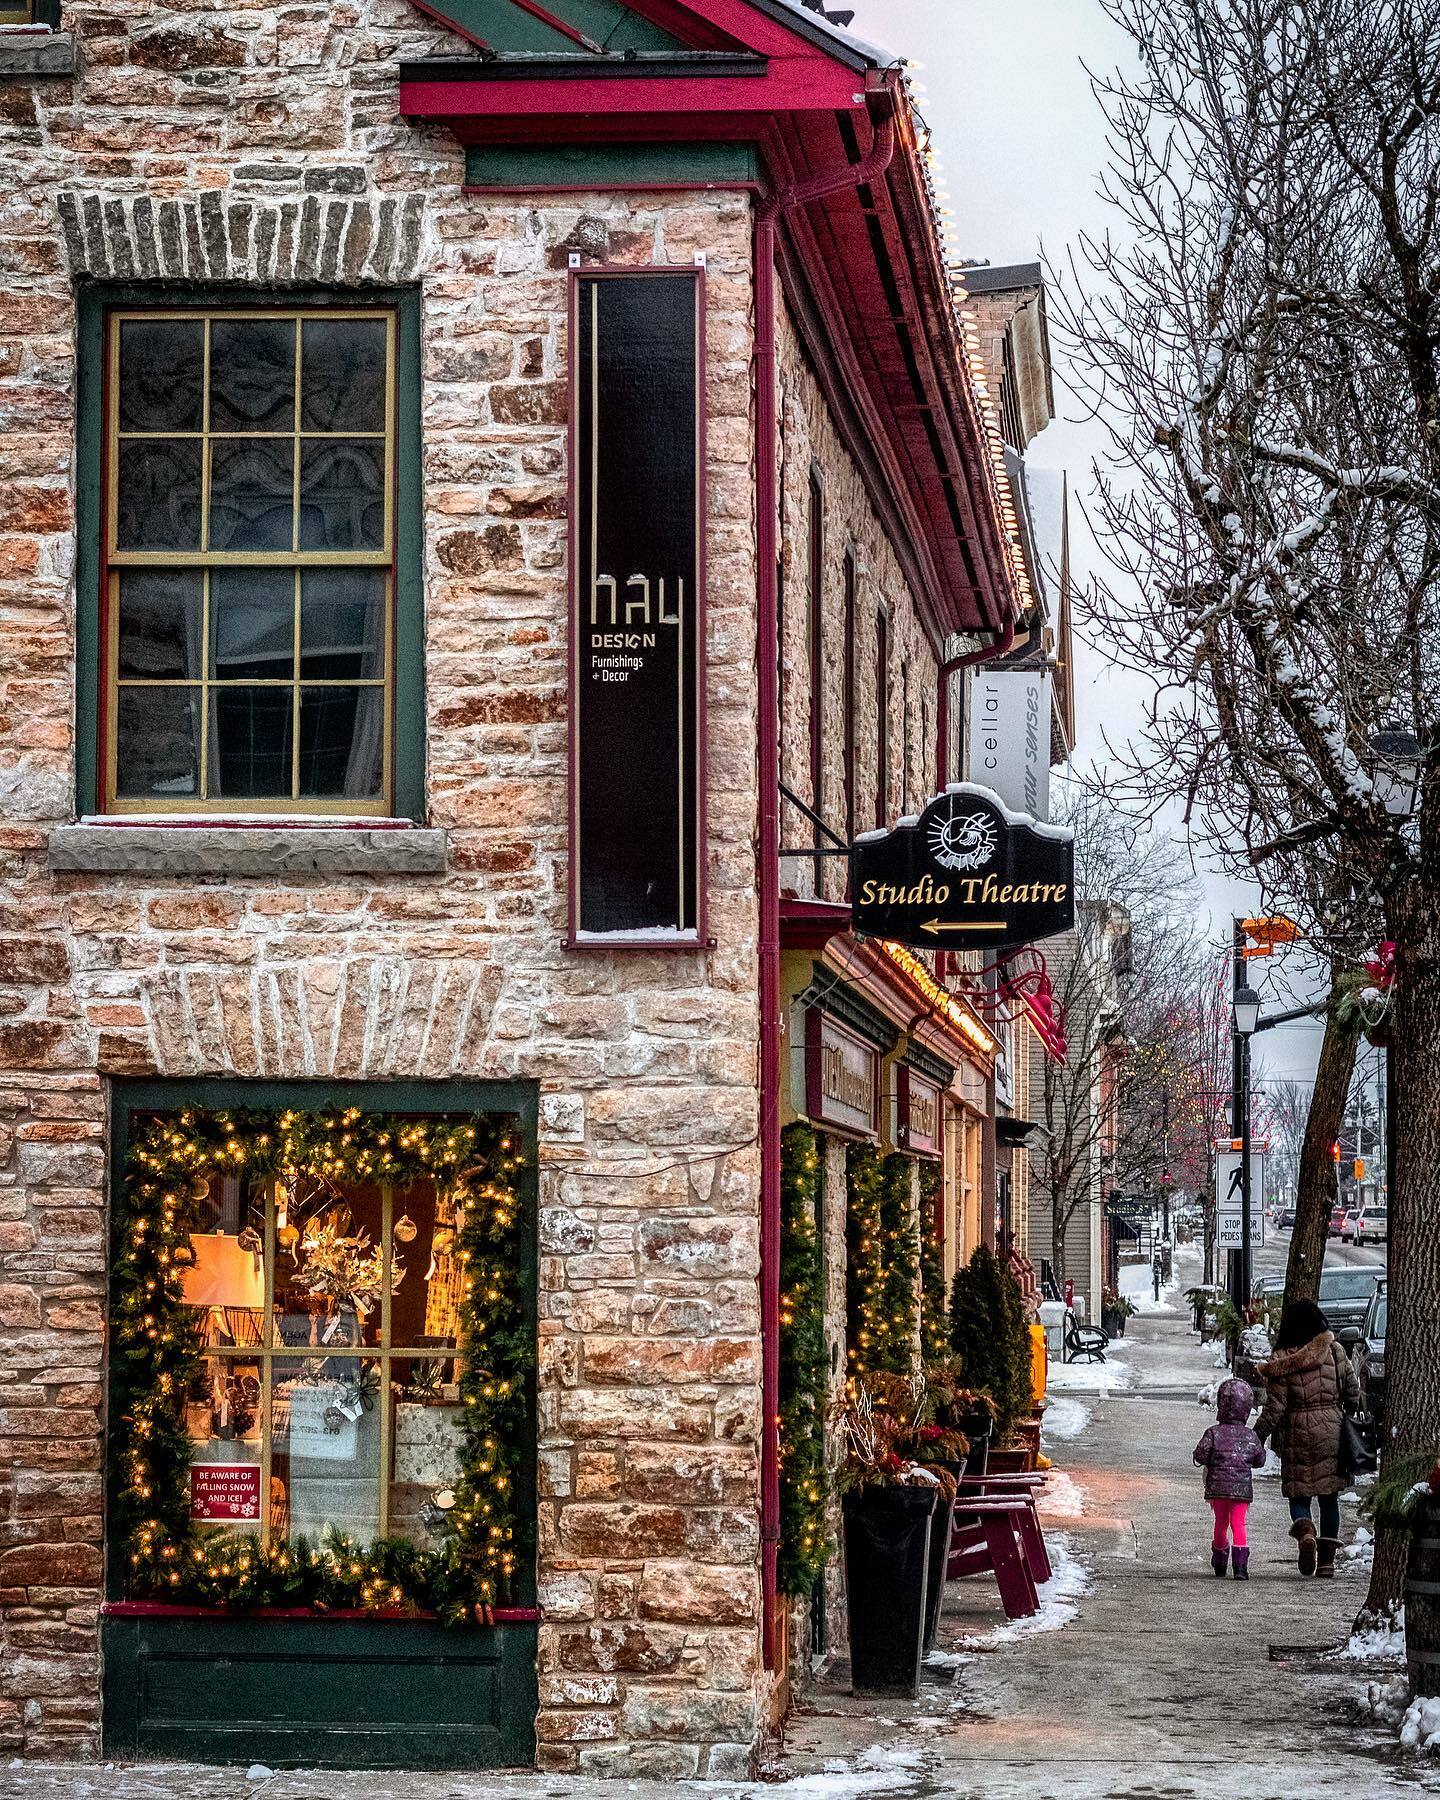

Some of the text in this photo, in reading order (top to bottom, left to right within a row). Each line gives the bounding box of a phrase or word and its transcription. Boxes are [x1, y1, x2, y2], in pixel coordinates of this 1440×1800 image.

[591, 633, 656, 649] DESIGN
[592, 655, 643, 670] Furnishings
[602, 670, 629, 682] Decor
[981, 685, 999, 769] cellar
[1025, 686, 1039, 763] senses
[859, 872, 1067, 905] Studio Theatre
[1224, 1220, 1241, 1229] STOP
[199, 1472, 252, 1480] BE AWARE OF
[196, 1483, 255, 1491] FALLING SNOW
[207, 1494, 243, 1503] AND ICE!
